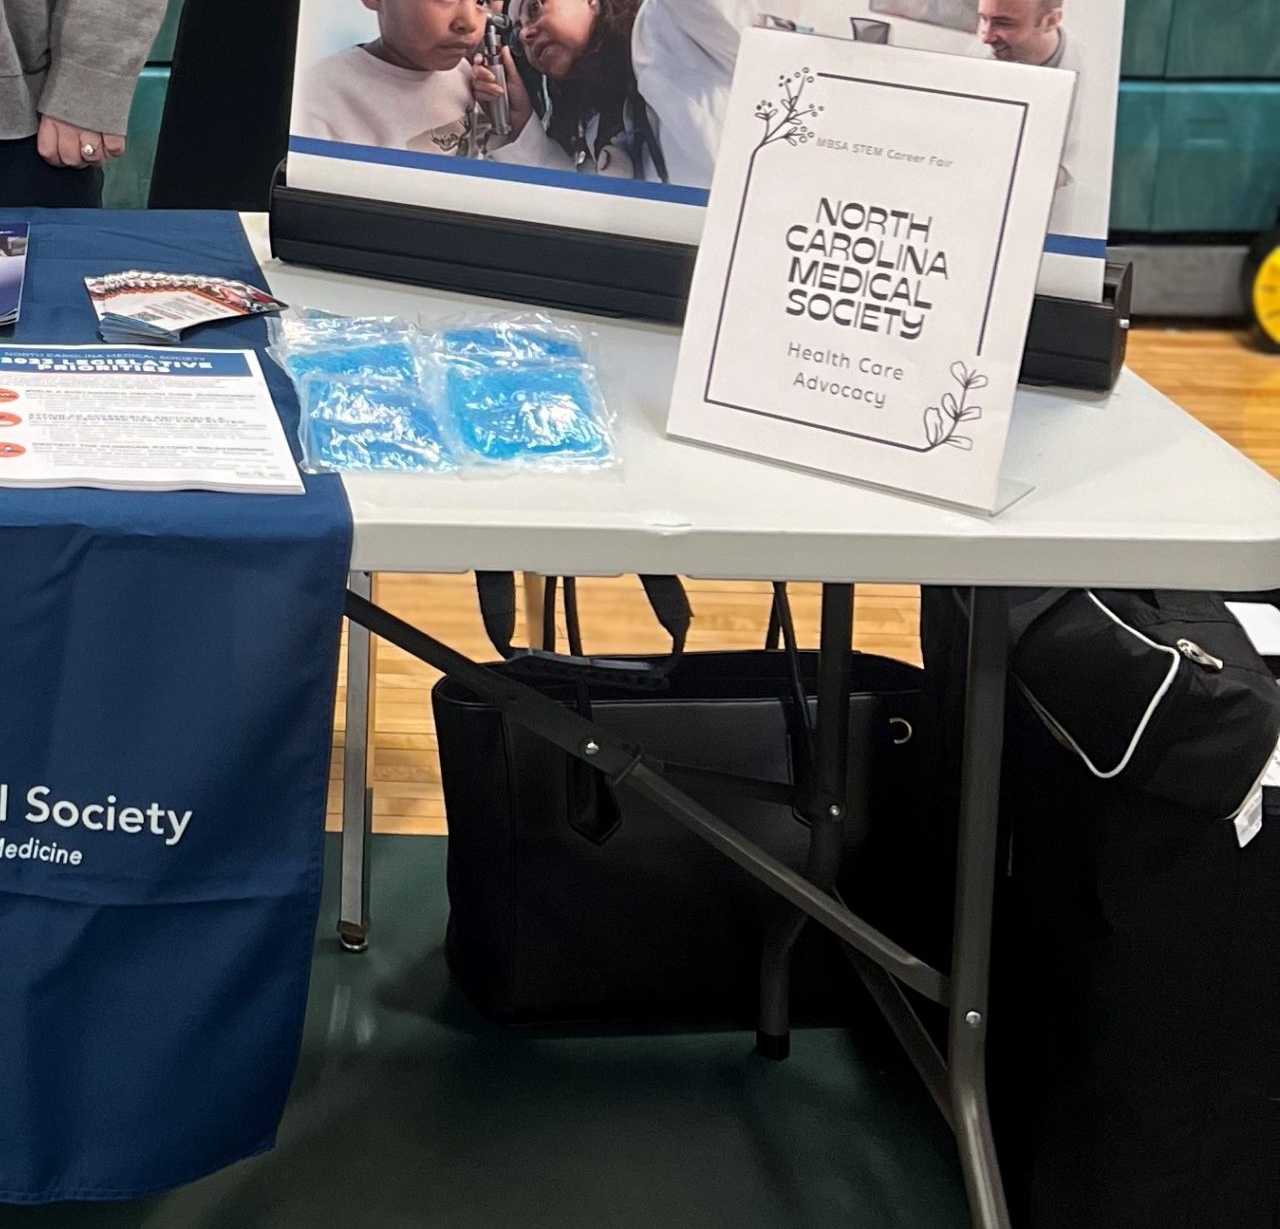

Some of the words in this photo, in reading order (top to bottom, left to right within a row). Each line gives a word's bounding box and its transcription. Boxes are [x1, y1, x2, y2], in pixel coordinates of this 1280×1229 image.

[816, 137, 849, 152] MBSA
[851, 142, 884, 157] STEM
[887, 149, 925, 166] Career
[929, 155, 953, 168] Fair
[816, 197, 933, 243] NORTH
[786, 224, 948, 279] CAROLINA
[787, 256, 932, 310] MEDICAL
[786, 289, 925, 340] SOCIETY
[37, 363, 170, 373] PRIORITIES
[62, 358, 213, 369] LEGISLATIVE
[787, 341, 851, 370] Health
[858, 357, 904, 380] Care
[793, 372, 886, 409] Advocacy
[25, 786, 192, 846] Society
